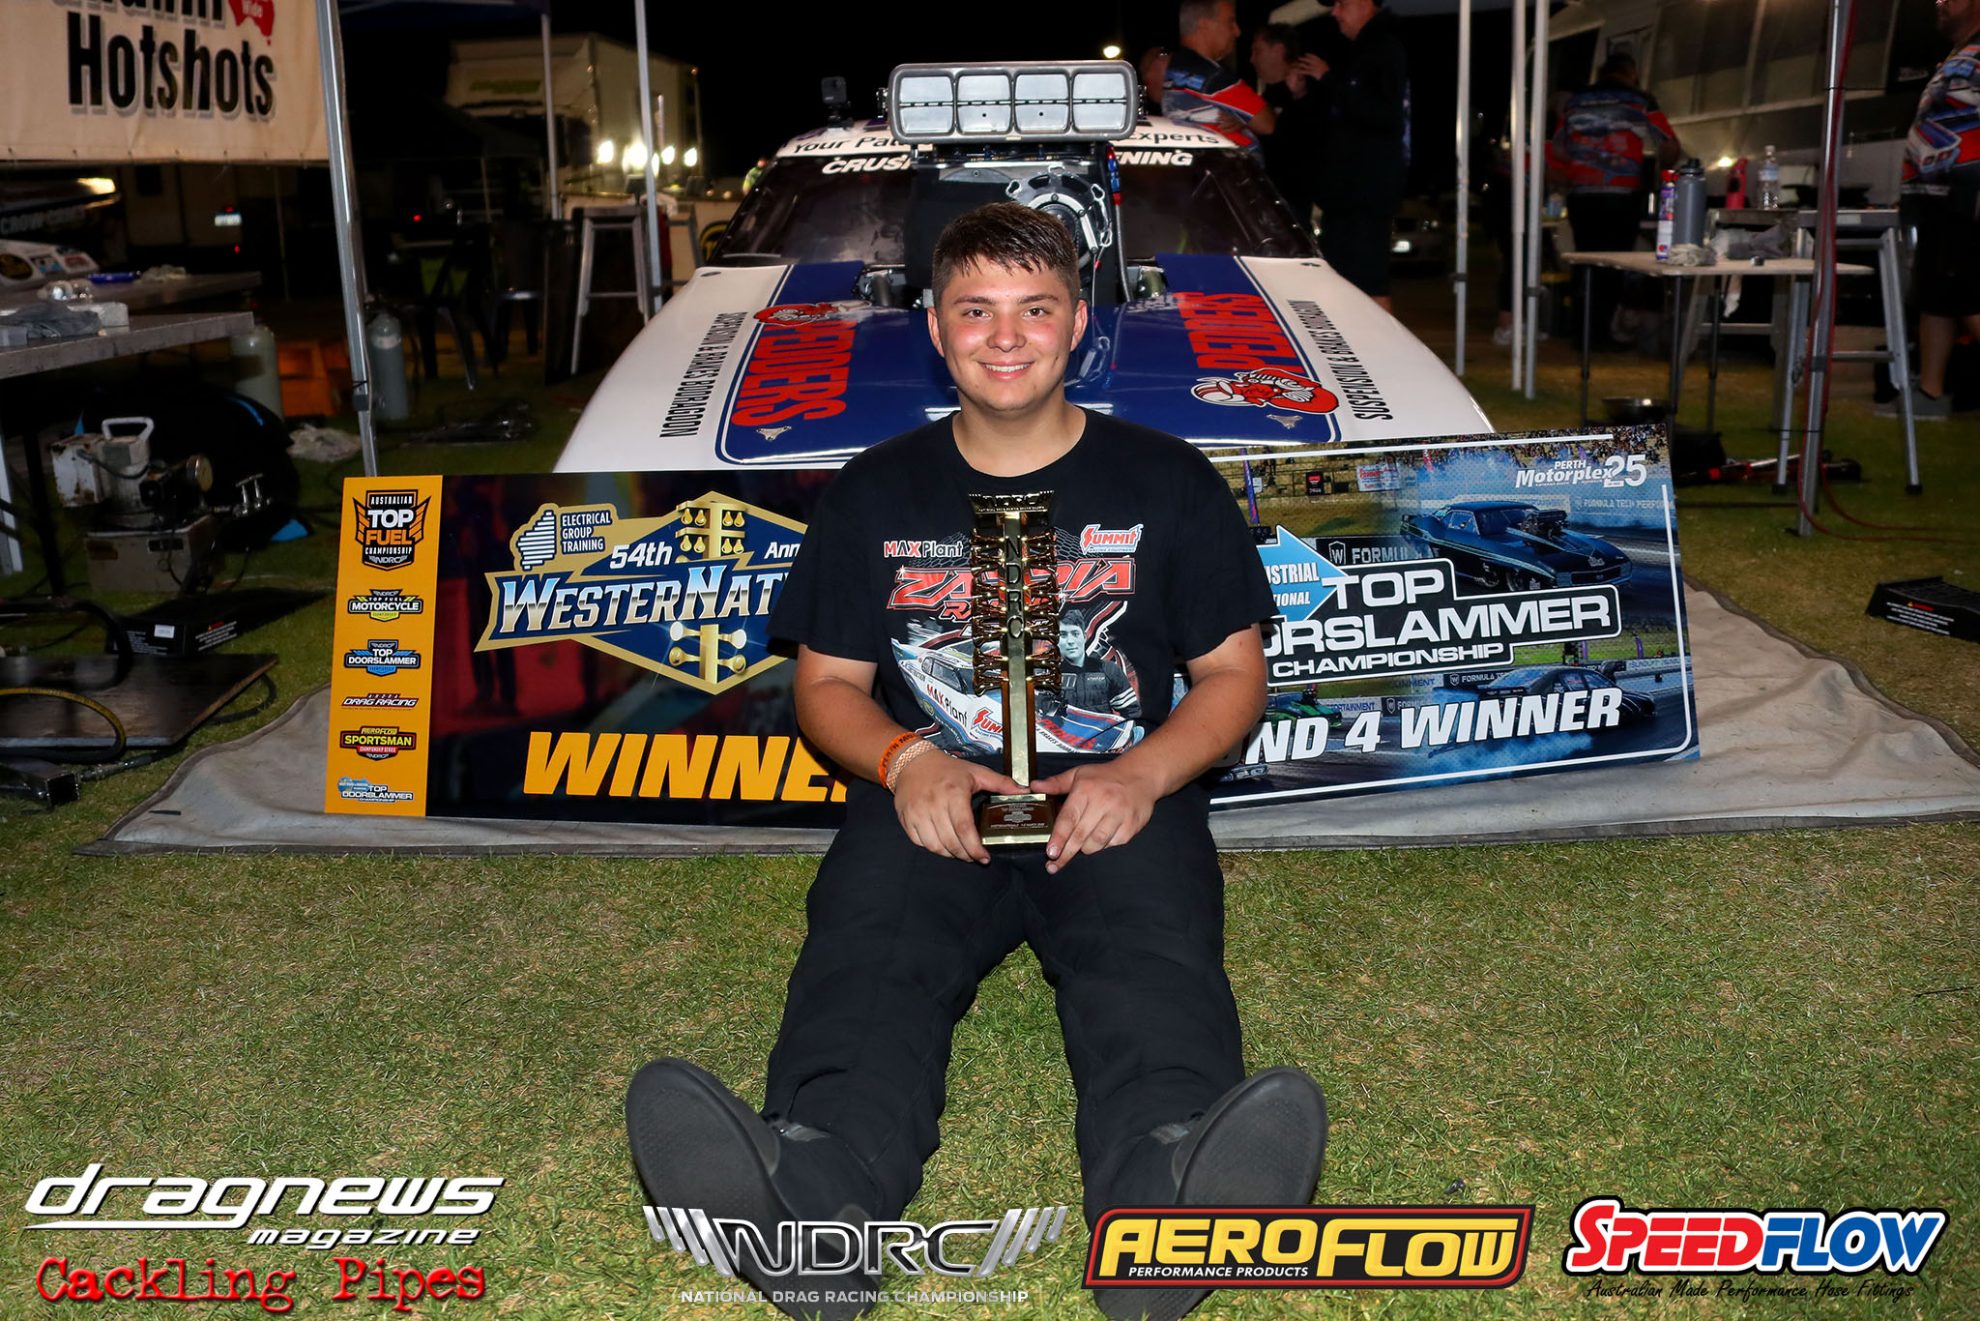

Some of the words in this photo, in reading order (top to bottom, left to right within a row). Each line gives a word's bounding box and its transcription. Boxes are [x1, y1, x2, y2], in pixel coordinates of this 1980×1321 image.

[67, 11, 275, 117] Hotshots
[794, 140, 848, 153] Your
[1116, 150, 1194, 165] NING
[1308, 330, 1354, 354] BRAKES
[1328, 363, 1393, 420] SUSPENSION
[660, 380, 716, 437] BOORAGOON
[1515, 466, 1613, 488] Motorplex
[1604, 454, 1647, 488] 25
[1555, 460, 1587, 470] PERTH
[371, 496, 412, 505] AUSTRALIAN
[367, 509, 414, 528] TOP
[562, 512, 611, 526] ELECTRICAL
[365, 529, 412, 545] FUEL
[562, 527, 592, 539] GROUP
[365, 547, 412, 555] CHAMPIONSHIP
[562, 540, 604, 552] TRAINING
[610, 541, 673, 569] 54th
[1322, 568, 1445, 610] TOP
[352, 602, 419, 611] MOTORCYCLE
[500, 565, 791, 632] WESTERNAT
[348, 656, 416, 665] DOORSLAMMER
[372, 649, 393, 657] TOP
[1272, 643, 1504, 679] CHAMPIONSHIP
[973, 709, 1003, 733] SUM
[1244, 717, 1329, 764] ND
[1344, 711, 1381, 752] 4
[1401, 687, 1623, 749] WINNER
[345, 735, 411, 746] SPORTSMAN
[523, 731, 847, 802] WINNE
[342, 791, 413, 799] DOORSLAMMER
